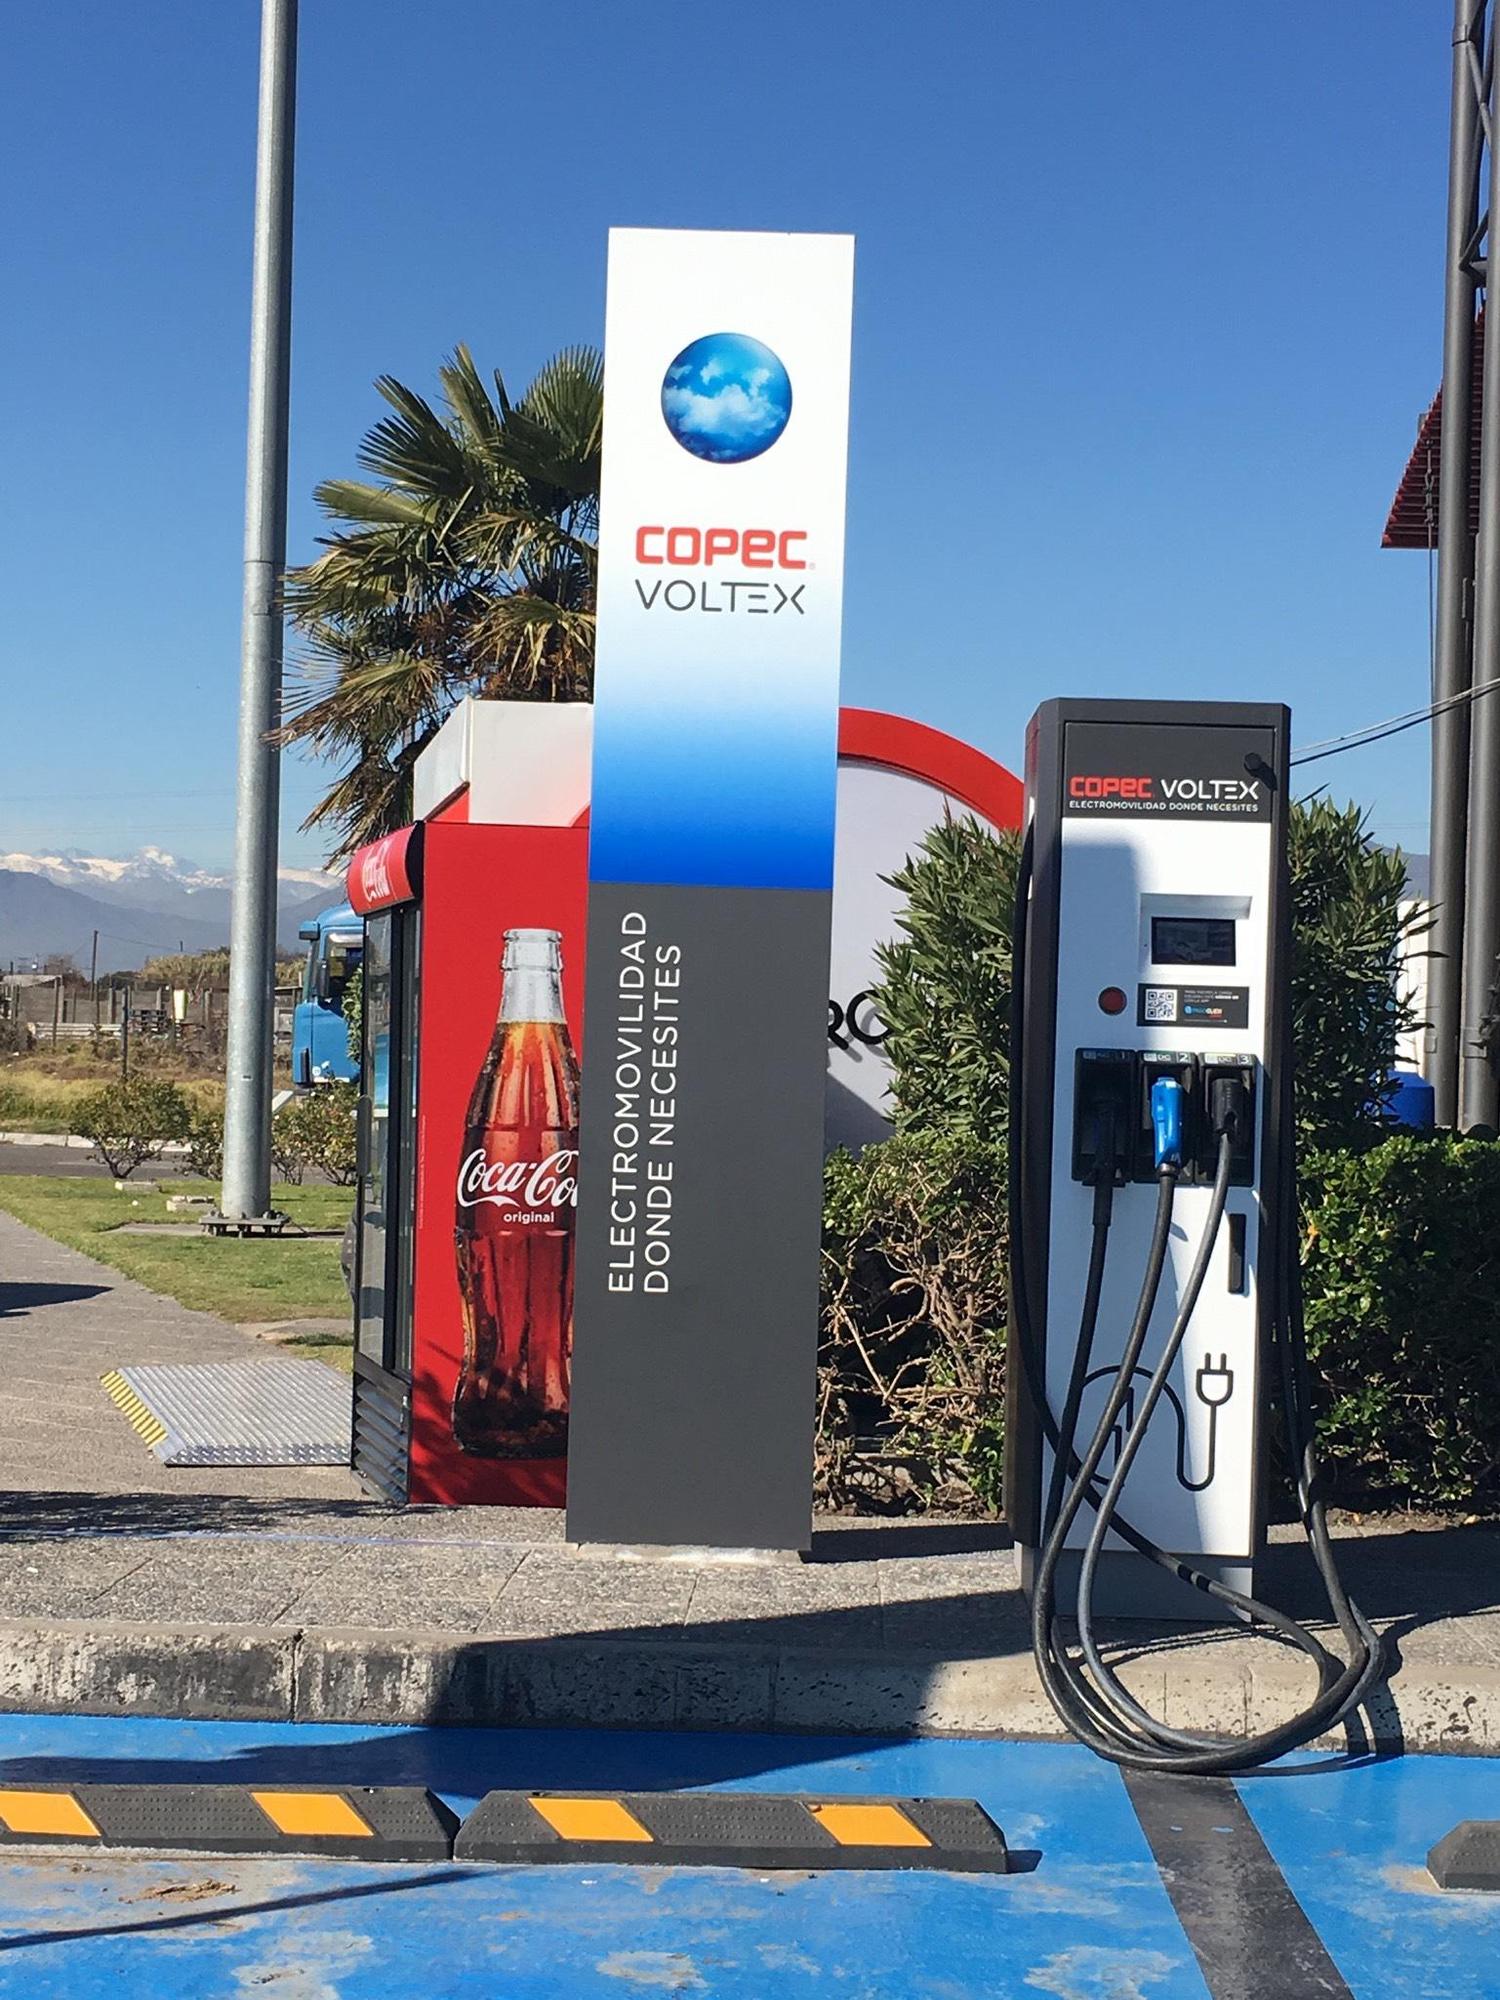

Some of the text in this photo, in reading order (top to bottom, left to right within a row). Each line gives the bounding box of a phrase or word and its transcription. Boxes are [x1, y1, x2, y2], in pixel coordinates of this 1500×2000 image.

[635, 526, 808, 570] COPEC
[635, 578, 806, 615] VOLTEX
[1069, 776, 1260, 801] COPEC VOLTEX
[1069, 800, 1260, 813] ELECTROMOVILIDAD DONDE NECESITES
[1180, 1052, 1189, 1063] 2
[608, 911, 647, 1293] ELECTROMOVILIDAD
[643, 944, 681, 1293] DONDE NECESITES
[457, 1148, 579, 1208] Coca-Co
[503, 1211, 554, 1224] original
